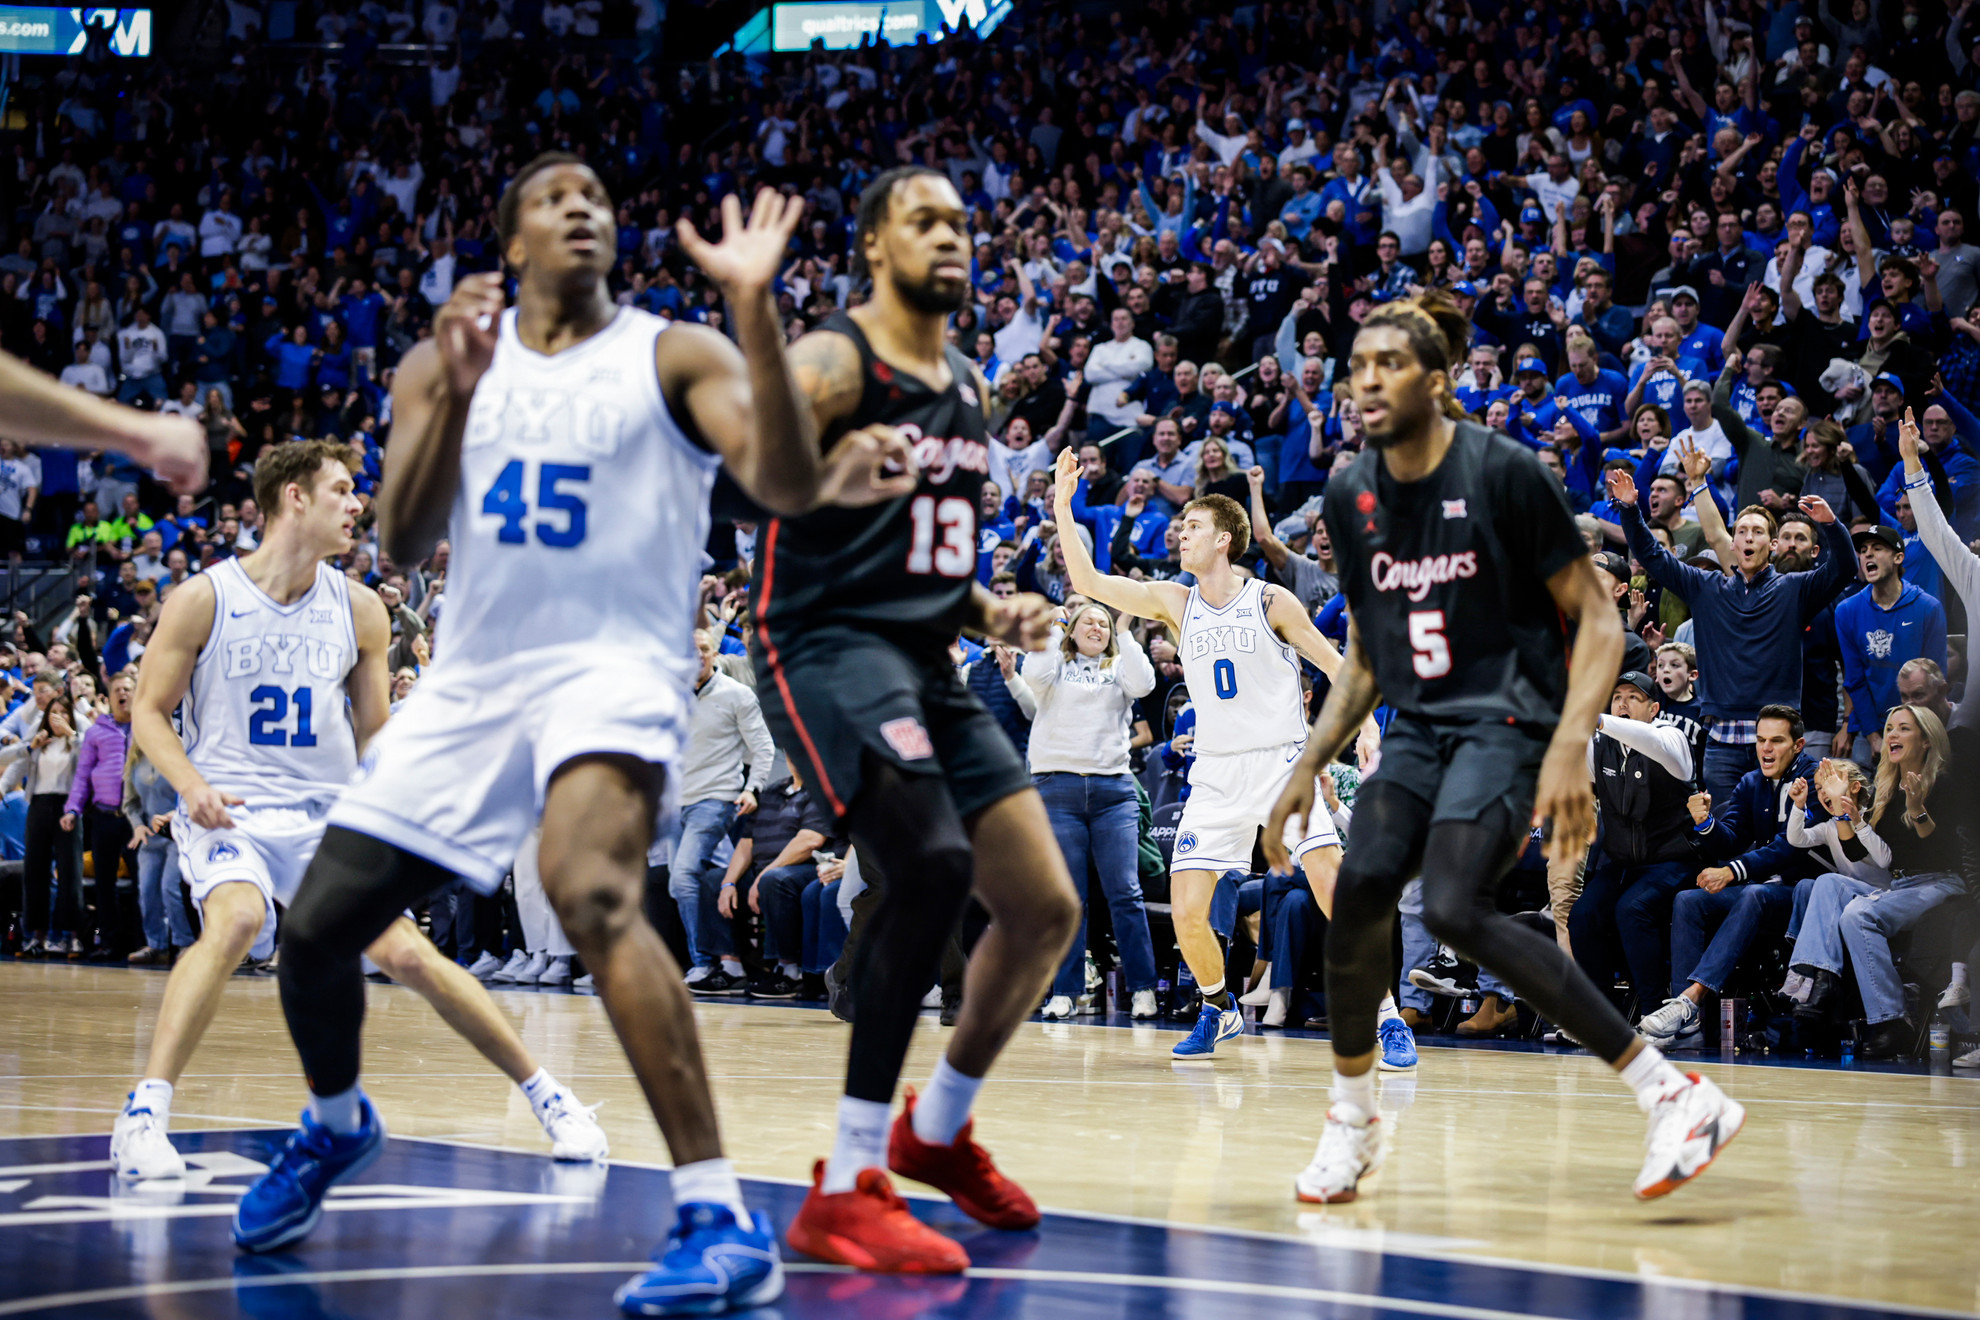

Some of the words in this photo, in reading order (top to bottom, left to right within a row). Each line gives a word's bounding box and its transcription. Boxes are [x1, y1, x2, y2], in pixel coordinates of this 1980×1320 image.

[802, 14, 918, 37] qualtricscom
[1568, 393, 1612, 408] OUGARS
[465, 388, 624, 461] BYU
[482, 459, 592, 548] 45
[906, 493, 976, 578] 13
[1371, 551, 1477, 602] Cougars
[226, 634, 342, 681] BYU
[1190, 626, 1256, 660] BYU
[1409, 609, 1453, 679] 5
[1213, 658, 1238, 700] 0
[250, 684, 317, 747] 21
[1659, 710, 1702, 745] YU
[1149, 827, 1178, 837] APPH
